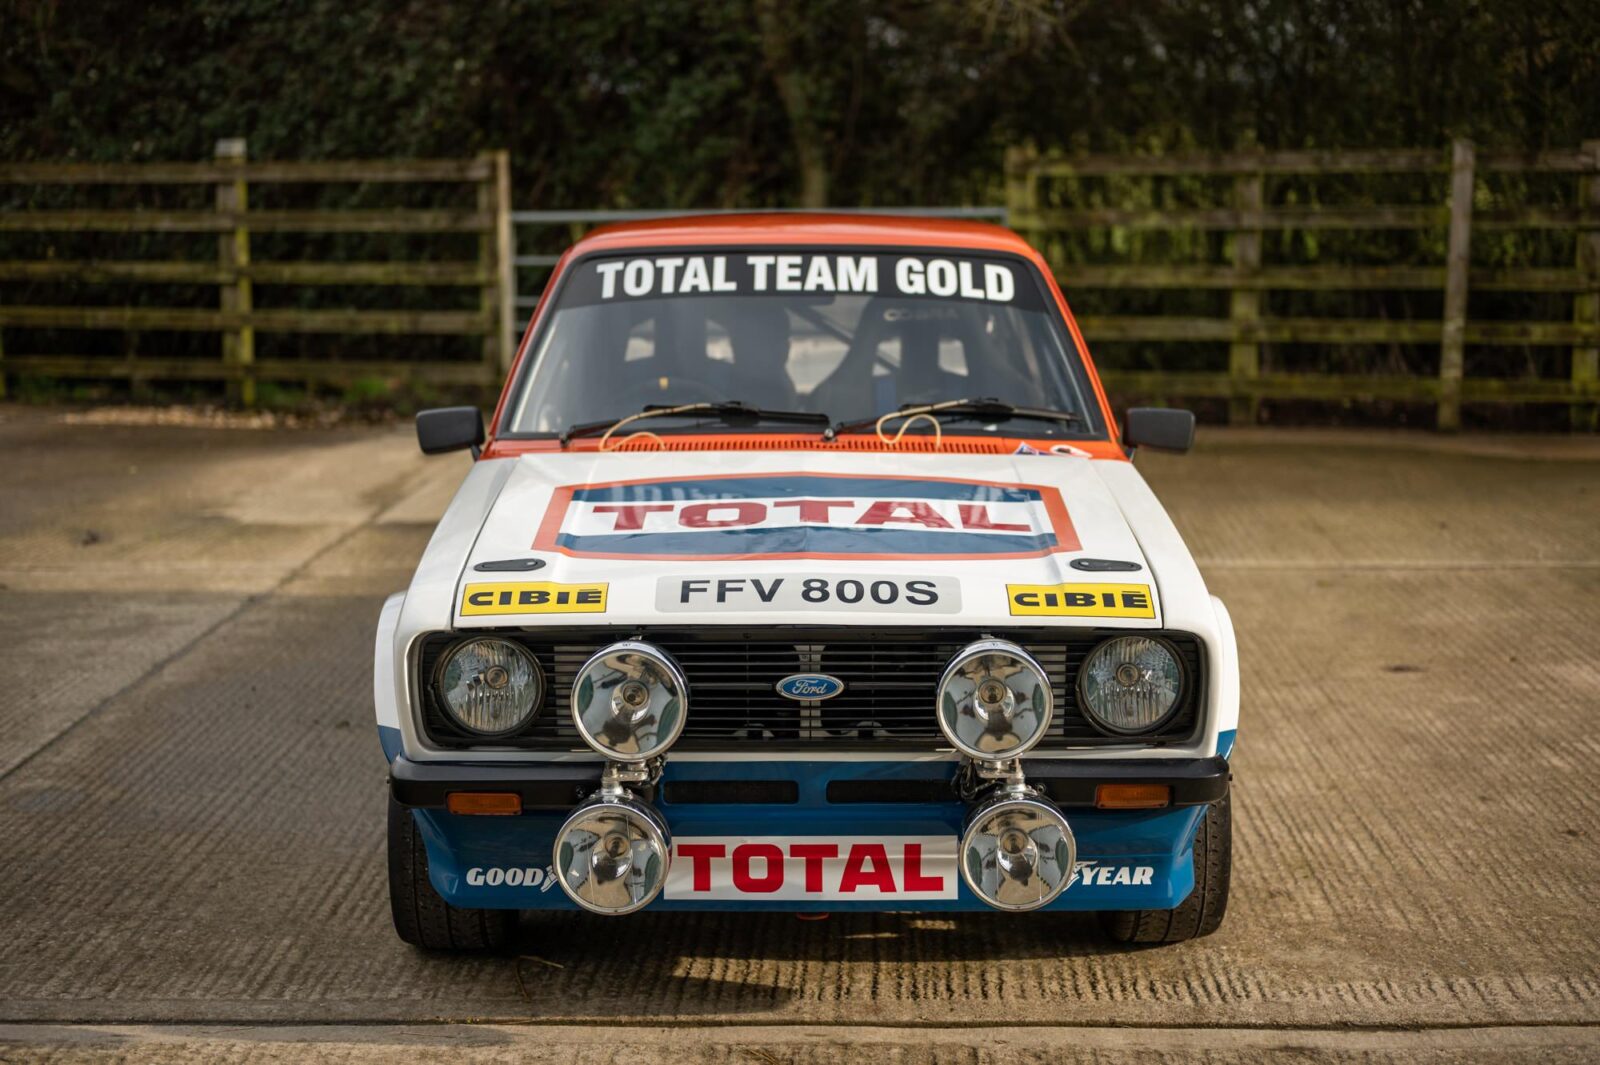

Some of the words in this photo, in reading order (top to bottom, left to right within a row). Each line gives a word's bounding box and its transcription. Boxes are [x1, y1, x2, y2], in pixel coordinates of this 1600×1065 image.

[596, 256, 737, 299] TOTAL
[747, 257, 878, 292] TEAM
[895, 258, 1015, 302] GOLD
[593, 499, 1032, 532] TOTAL
[681, 578, 785, 603] FFV
[801, 578, 939, 606] 800S
[792, 679, 827, 694] Ford
[466, 867, 545, 886] GOOD
[677, 843, 944, 893] TOTAL
[1081, 866, 1154, 886] YEAR
